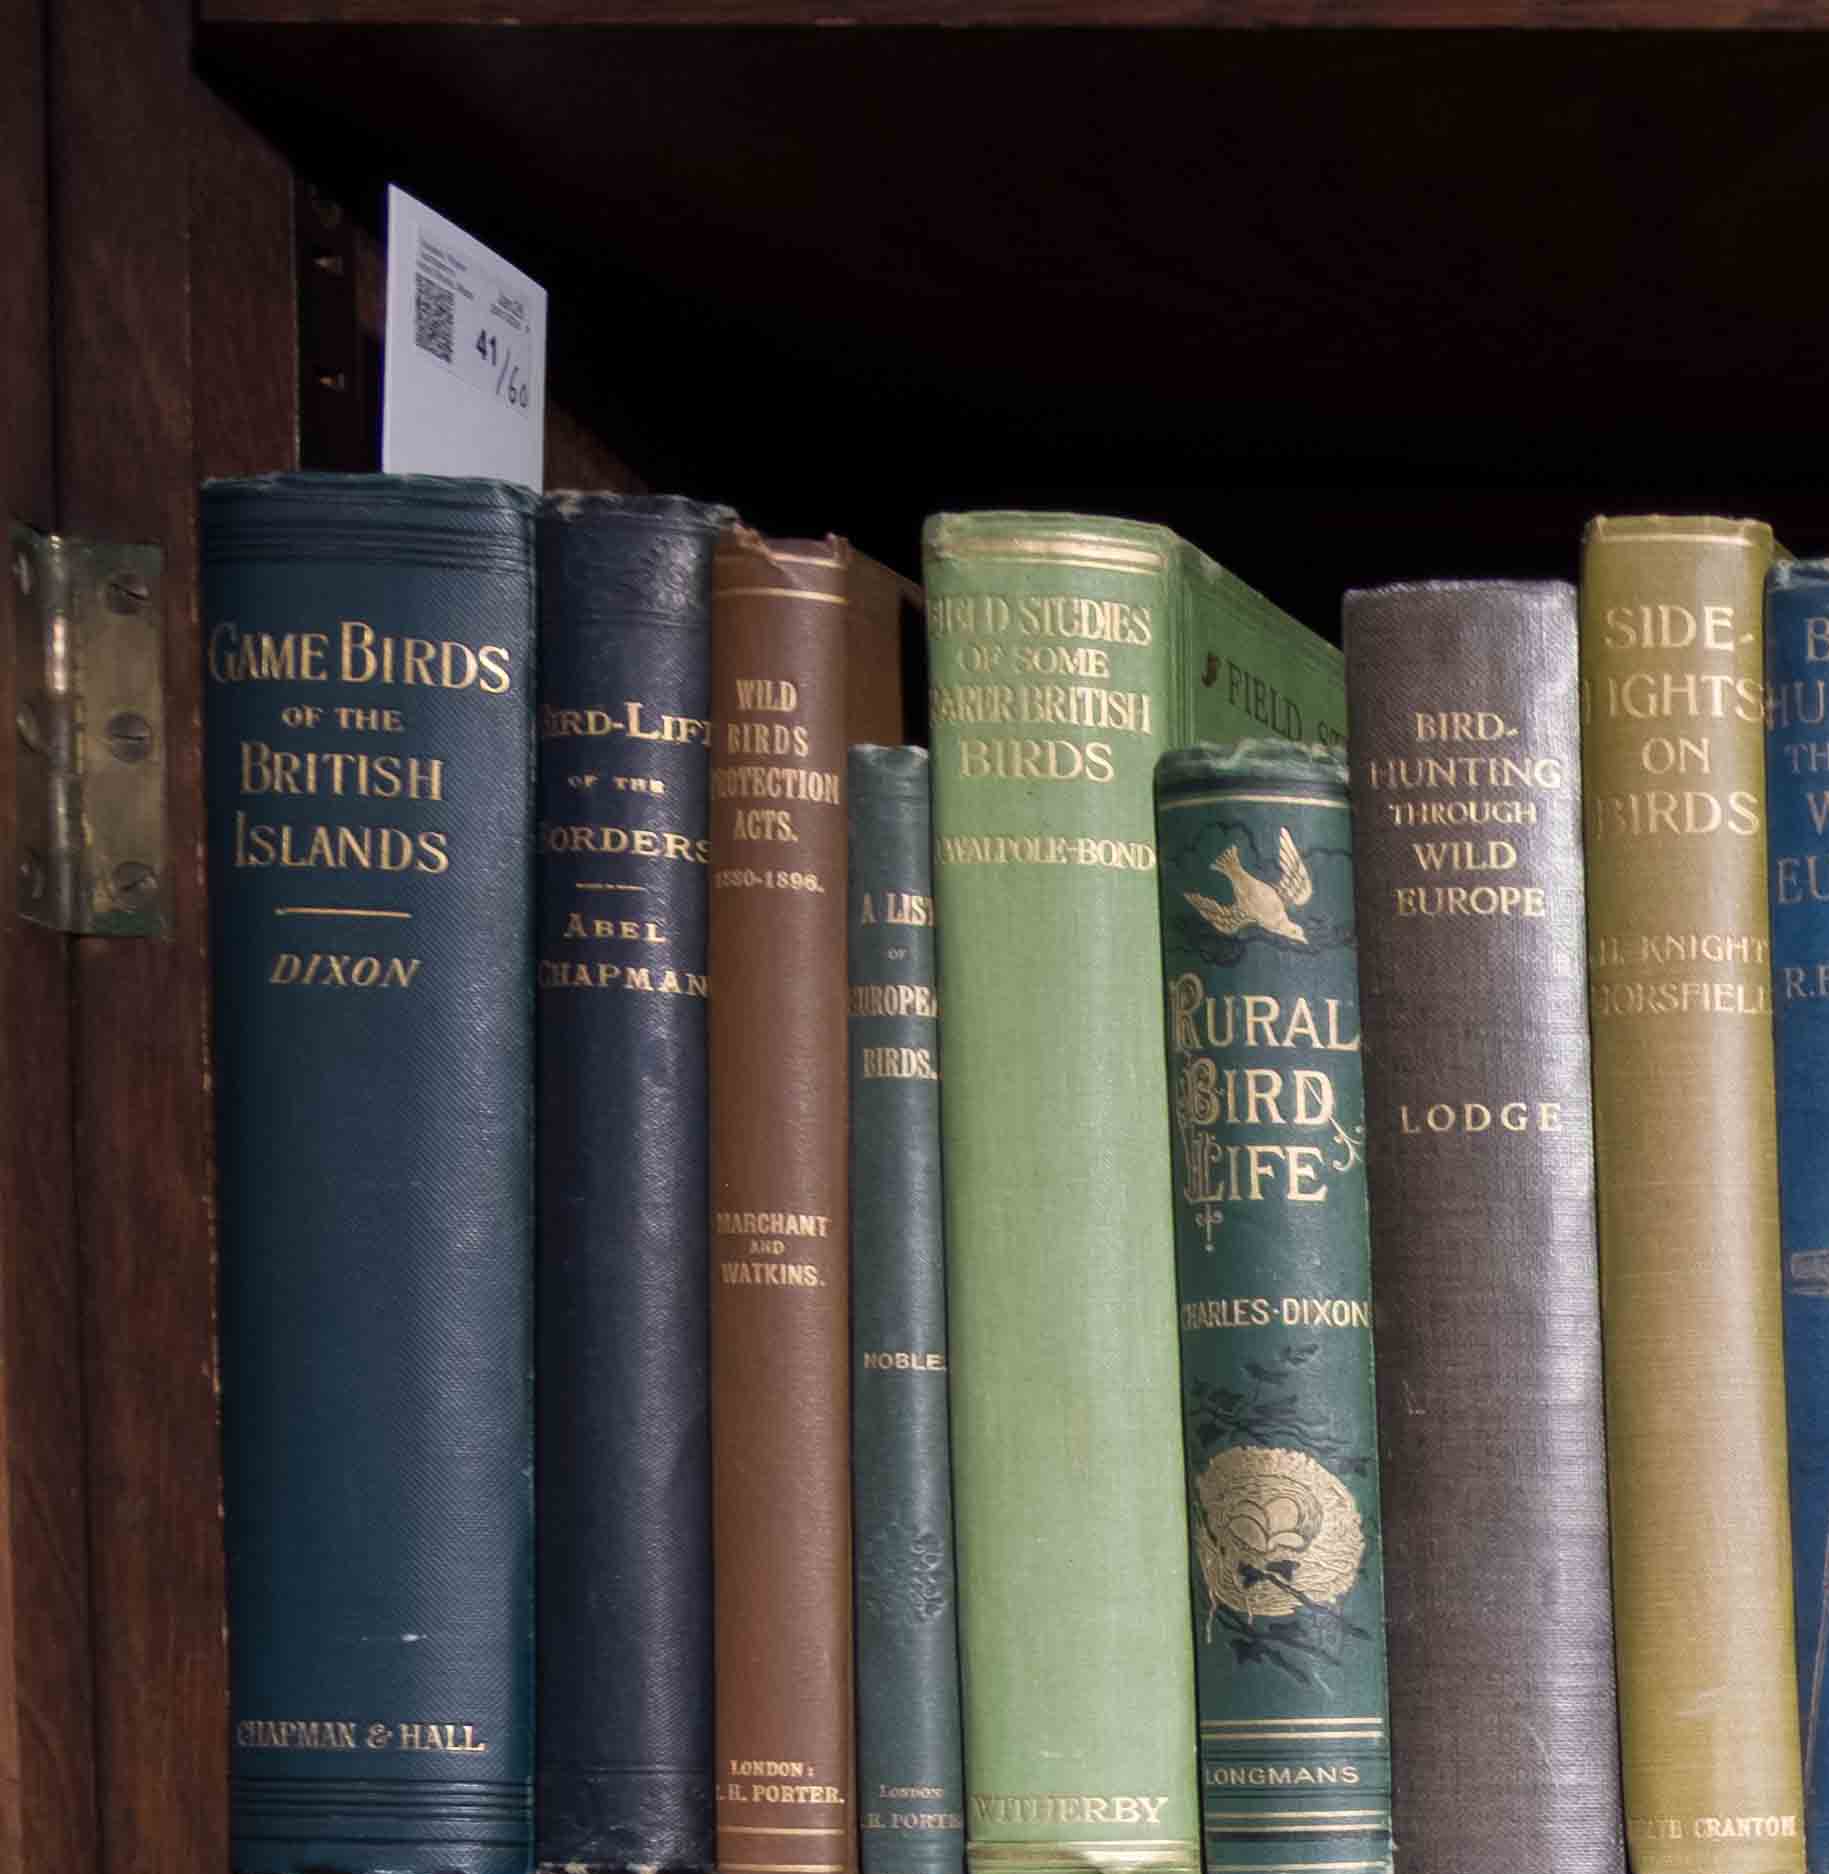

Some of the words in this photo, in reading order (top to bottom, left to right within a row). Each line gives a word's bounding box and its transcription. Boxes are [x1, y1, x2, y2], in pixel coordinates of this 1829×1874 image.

[209, 624, 328, 684] GAME
[340, 622, 510, 694] BIRDS
[1014, 647, 1109, 677] SOME
[737, 680, 797, 712] WILD
[282, 707, 320, 728] OF
[336, 707, 402, 731] THE
[960, 740, 1114, 784] BIRDS
[1641, 737, 1711, 774] ON
[241, 743, 445, 801] BRITISH
[1389, 804, 1537, 825] THROUGH
[234, 812, 449, 874] ISLANDS
[1413, 842, 1516, 871] WILD
[1396, 886, 1545, 918] EUROPE
[564, 915, 667, 942] ABEL
[270, 953, 421, 987] DIXON
[1170, 972, 1359, 1052] RURAL
[1402, 1104, 1564, 1134] LODGE
[1206, 1766, 1360, 1786] LONGMANS
[973, 1797, 1169, 1823] WITHERBY
